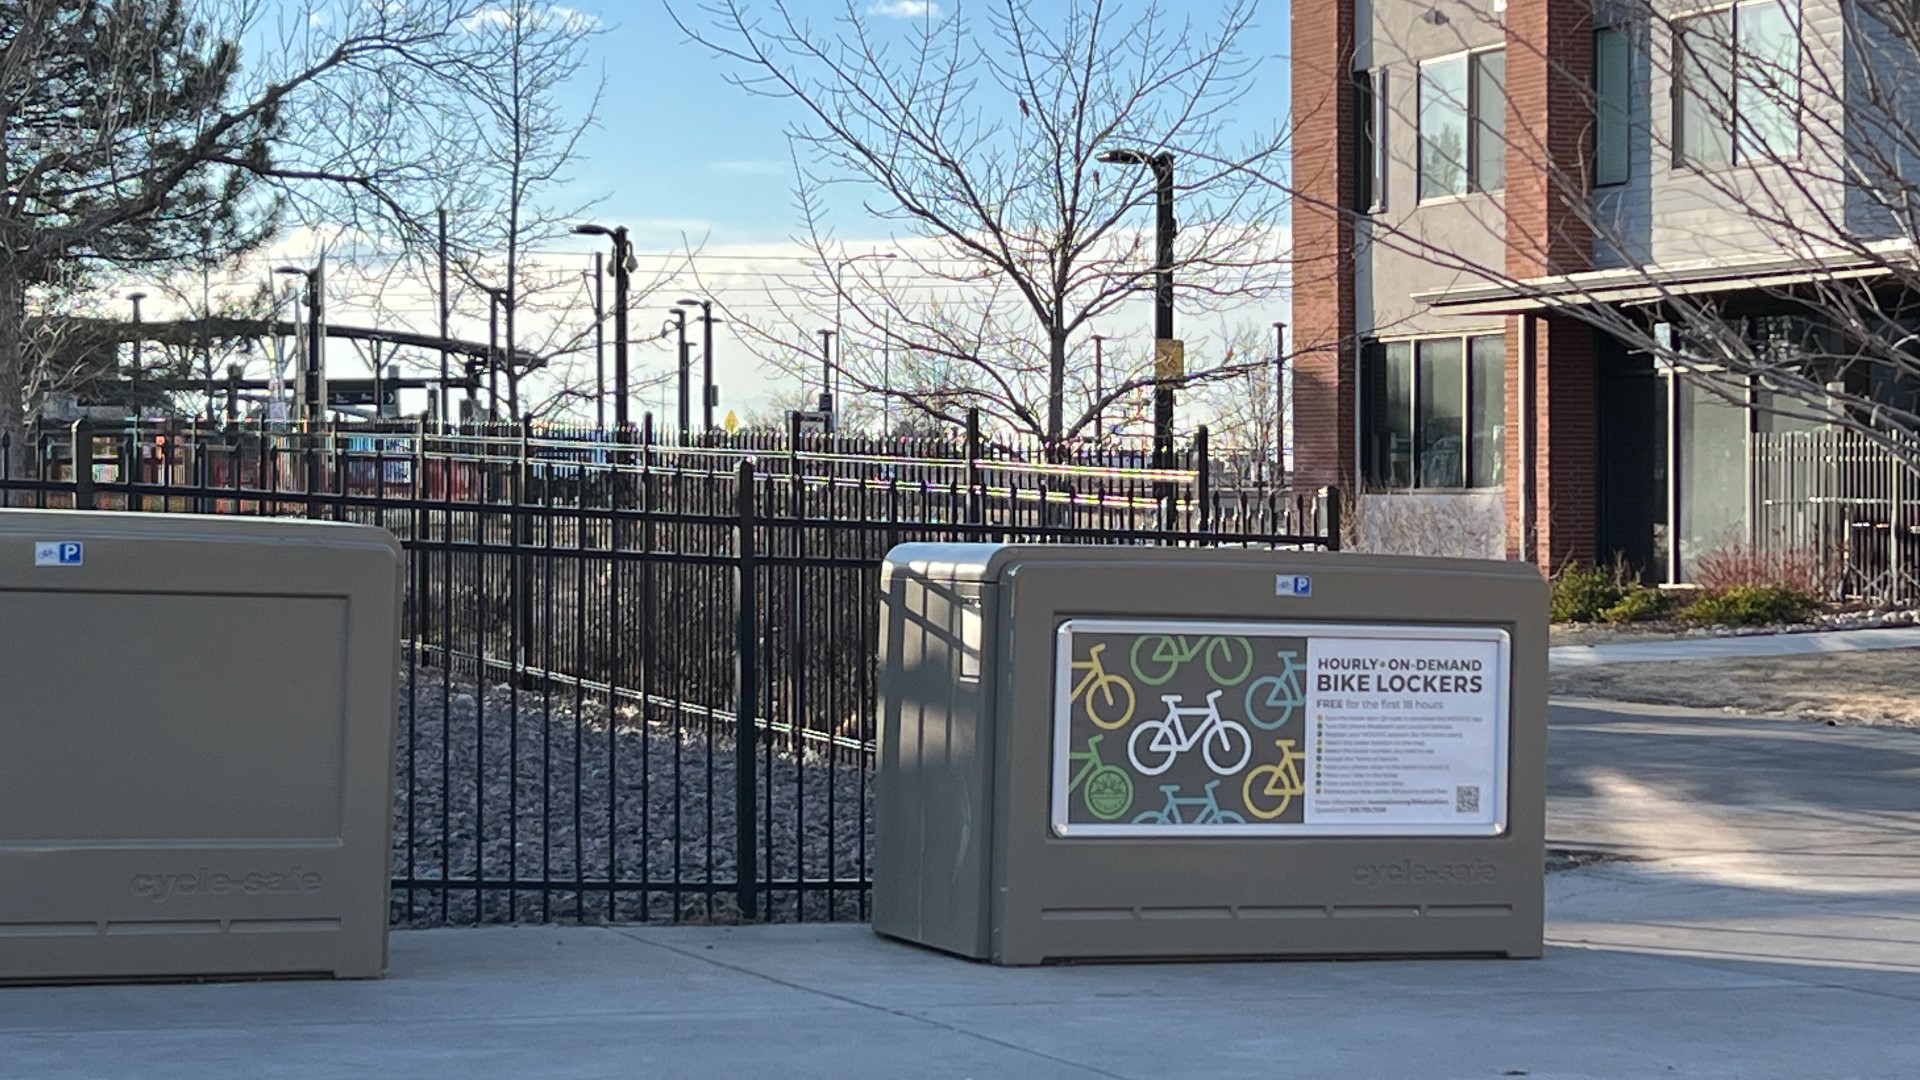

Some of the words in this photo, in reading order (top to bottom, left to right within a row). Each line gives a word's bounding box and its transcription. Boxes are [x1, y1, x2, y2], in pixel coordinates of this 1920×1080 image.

[64, 544, 78, 561] P
[1297, 578, 1308, 592] P
[1317, 657, 1379, 671] HOURLY
[1388, 658, 1483, 672] ON-DEMAND
[1316, 673, 1371, 692] BIKE
[1376, 674, 1483, 693] LOCKERS
[1316, 699, 1344, 709] FREE
[1346, 699, 1360, 709] for
[1362, 699, 1380, 709] the
[1380, 699, 1401, 710] first
[1415, 700, 1444, 710] hours
[1352, 858, 1498, 888] cycle-safe
[130, 866, 323, 903] cycle-safe
